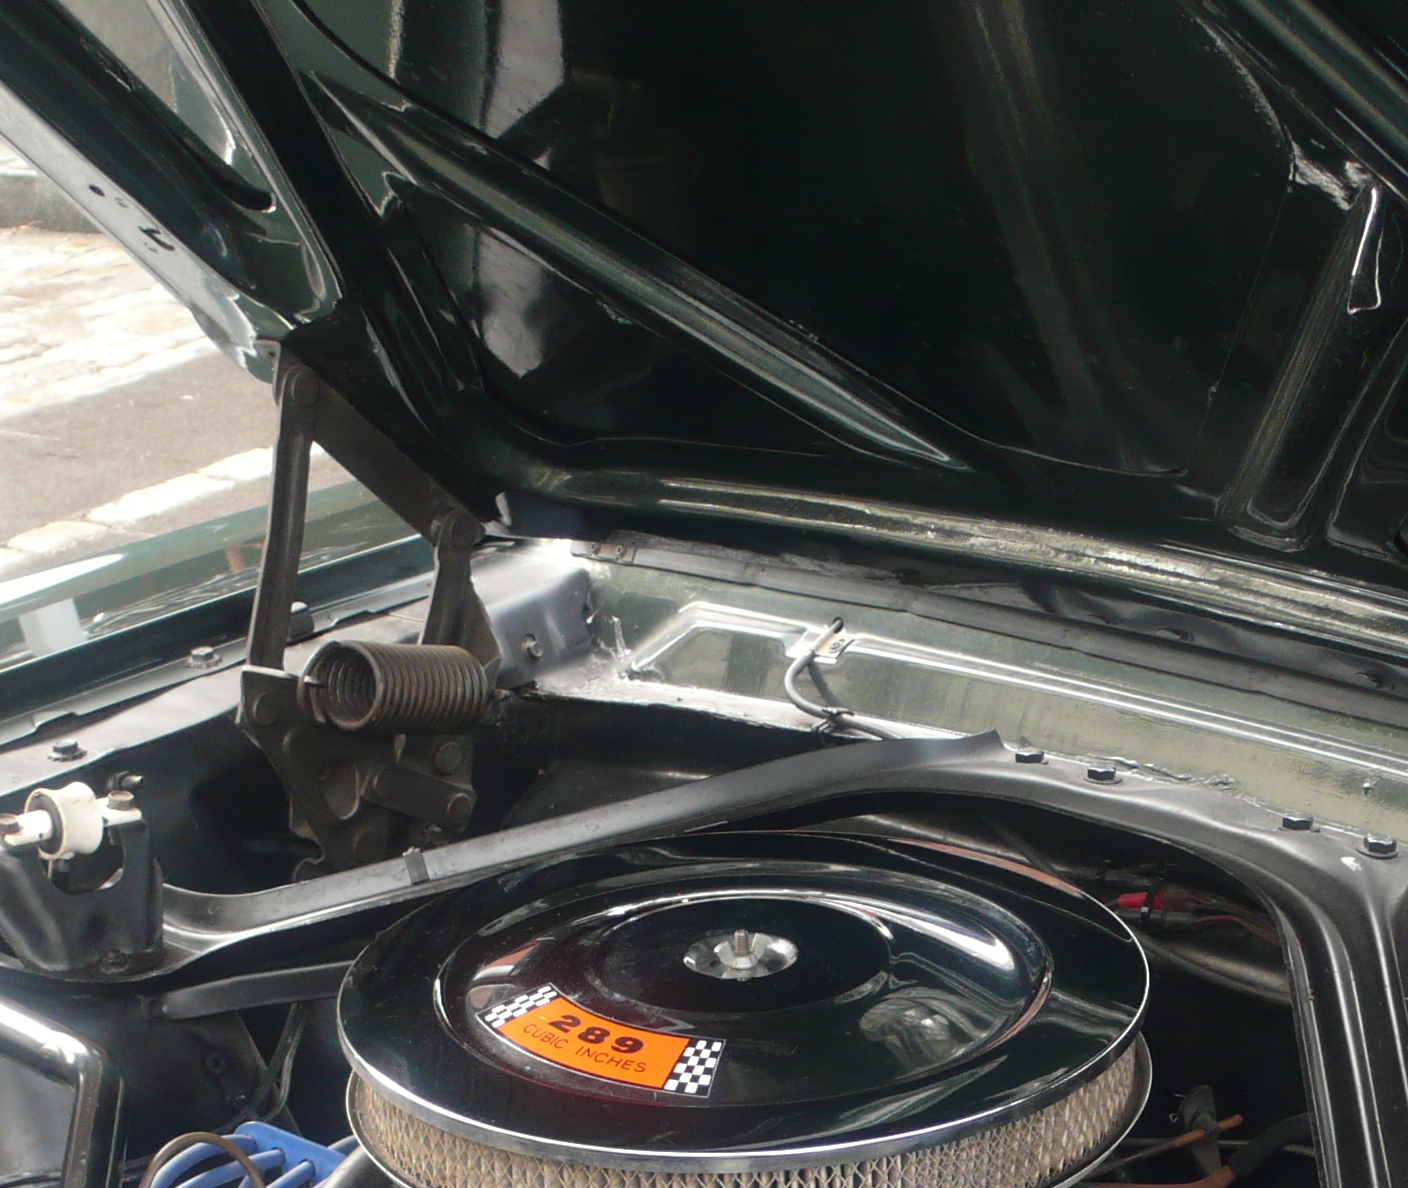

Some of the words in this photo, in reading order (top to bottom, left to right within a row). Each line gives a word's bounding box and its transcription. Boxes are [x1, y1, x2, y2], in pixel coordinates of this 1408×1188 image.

[523, 1023, 569, 1049] CUBIC
[575, 1045, 647, 1073] INCHES
[547, 1014, 644, 1054] 289
